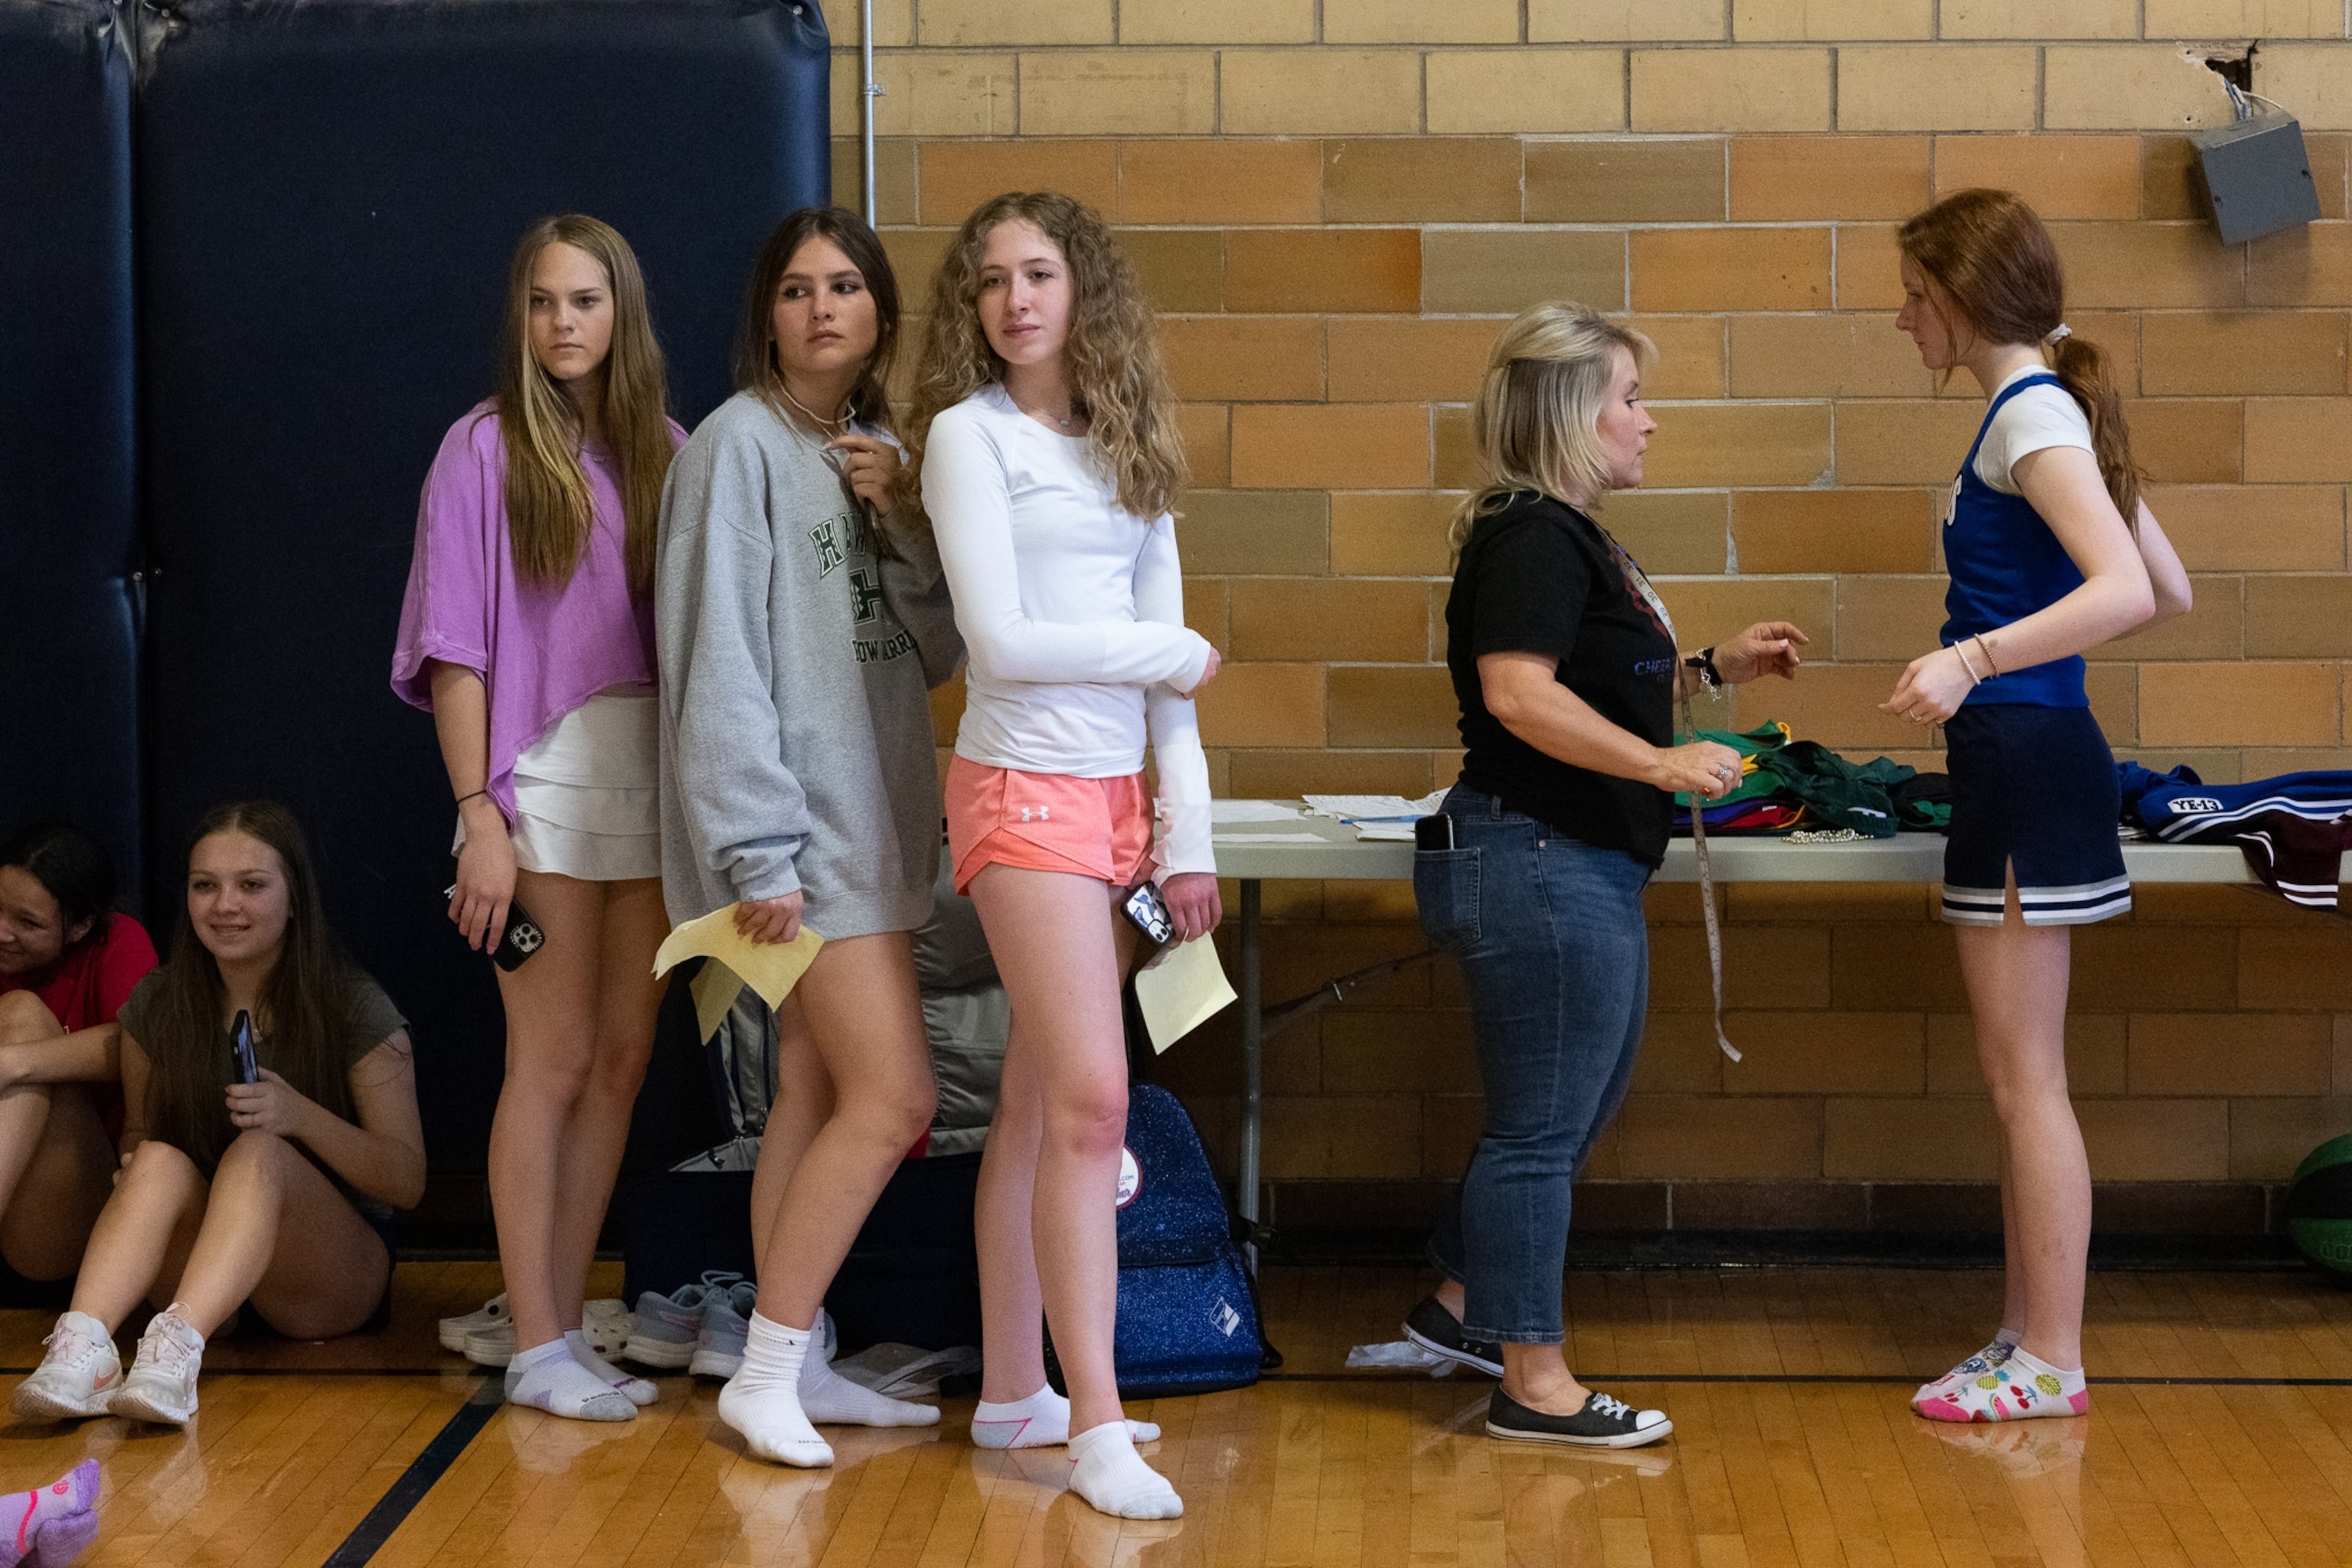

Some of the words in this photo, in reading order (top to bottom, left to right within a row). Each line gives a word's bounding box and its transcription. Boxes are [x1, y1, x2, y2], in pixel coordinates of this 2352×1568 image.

[1623, 561, 1633, 571] 32
[1635, 577, 1645, 587] 31
[1647, 591, 1658, 603] 30
[2172, 799, 2220, 811] YE-13
